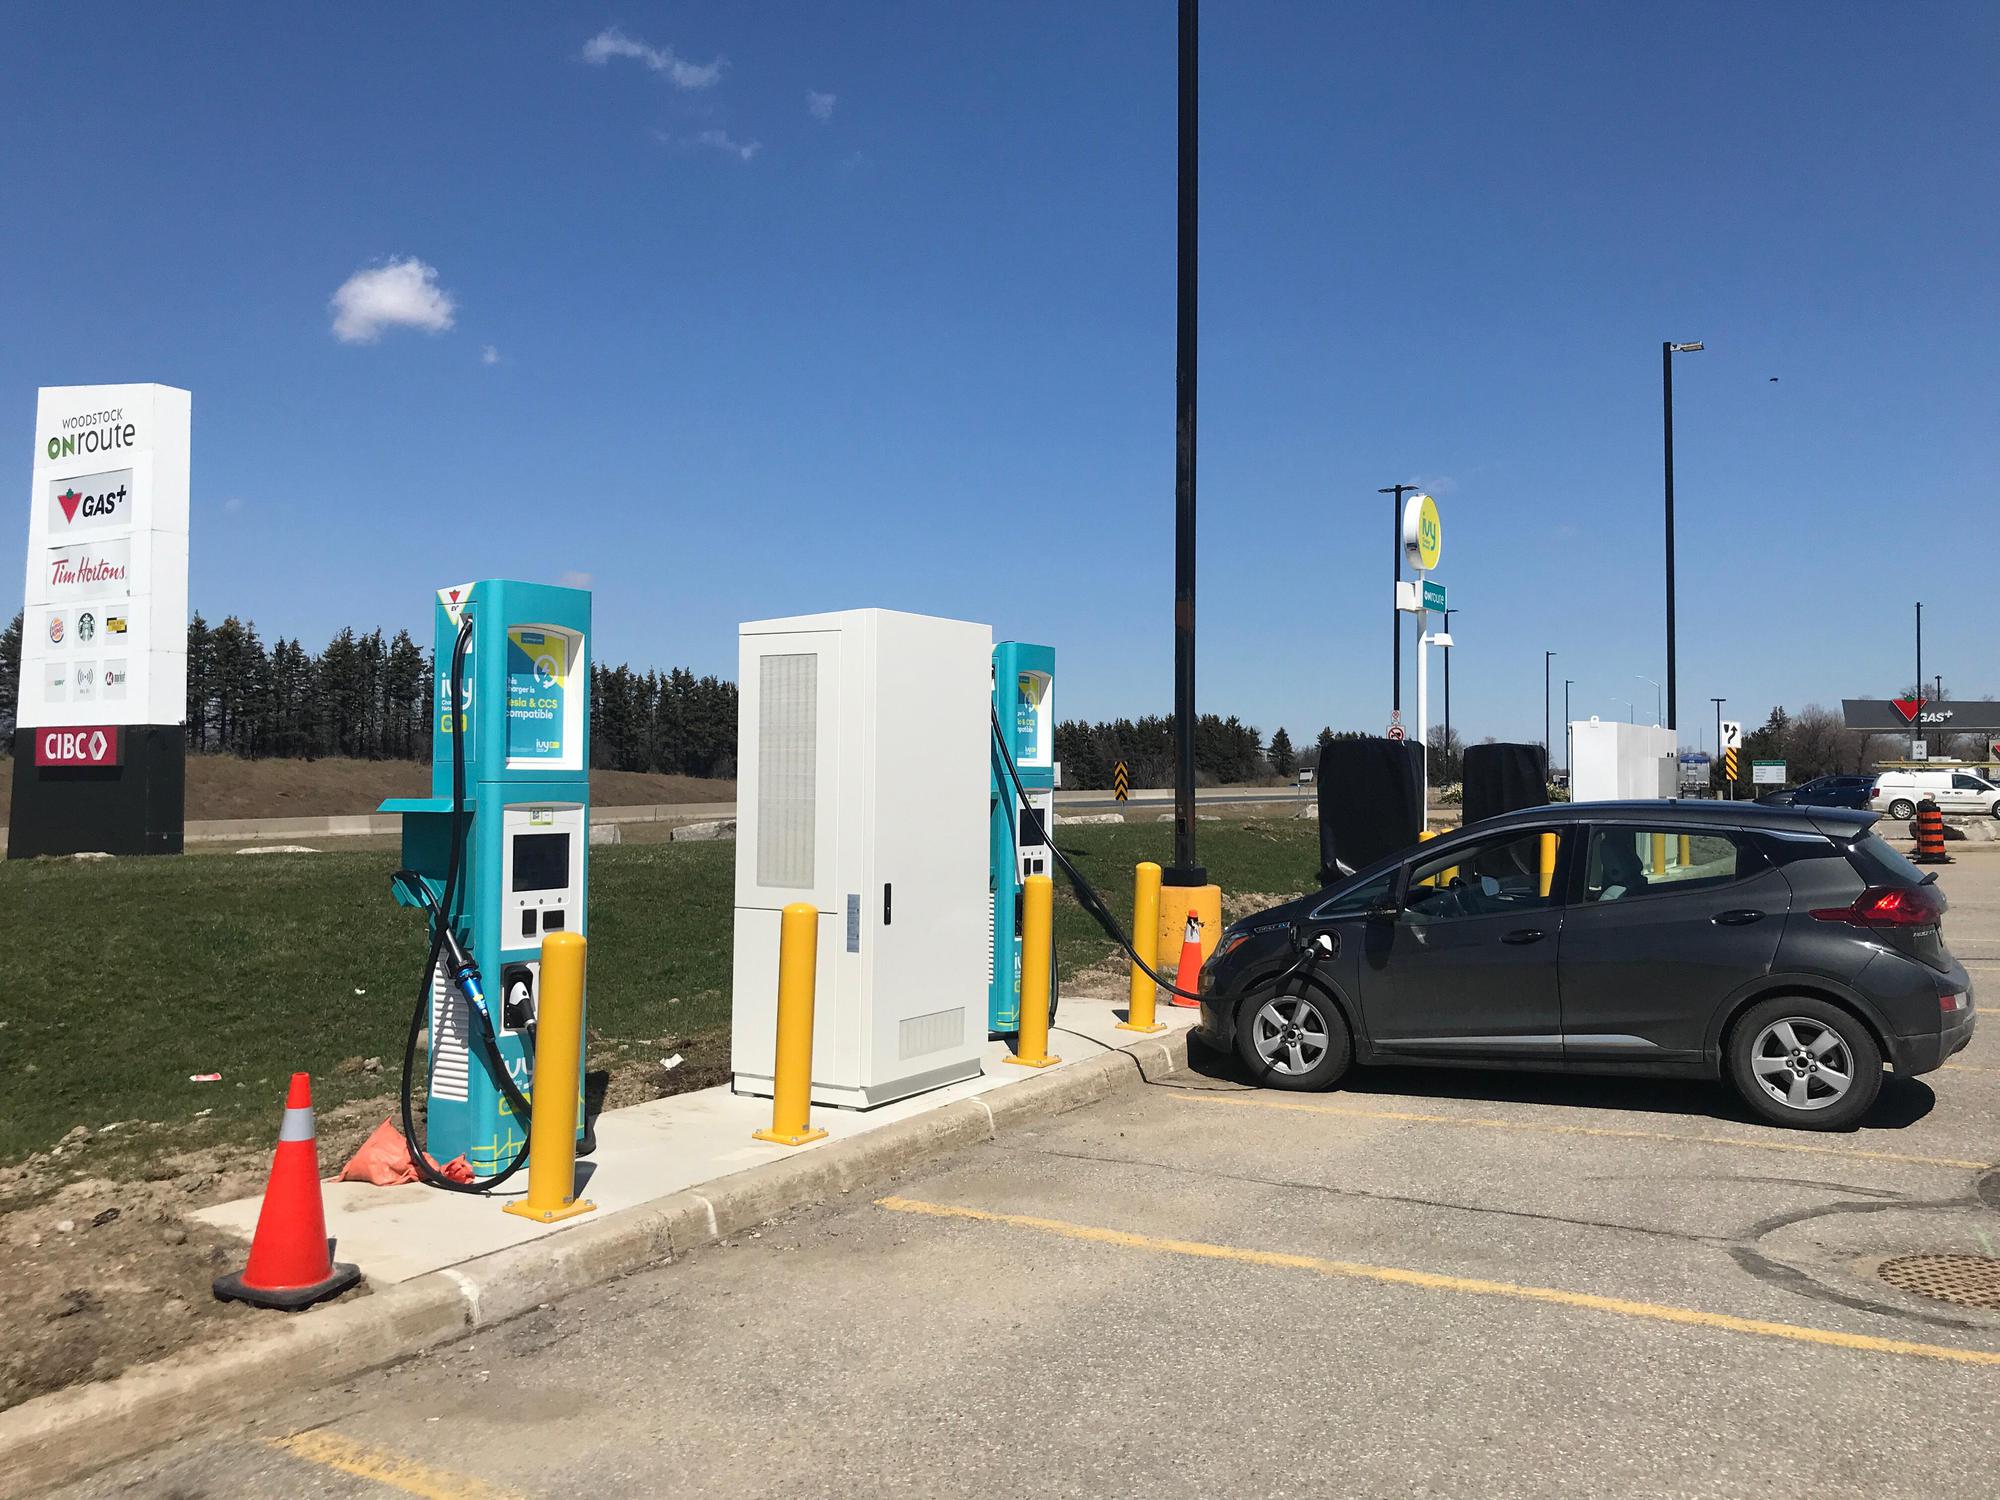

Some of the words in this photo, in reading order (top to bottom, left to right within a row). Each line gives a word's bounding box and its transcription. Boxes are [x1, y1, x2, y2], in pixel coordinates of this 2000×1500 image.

[62, 408, 123, 429] WOODSTOCK
[47, 423, 136, 460] ONroute
[82, 484, 127, 518] GAS+
[1422, 511, 1436, 551] ivy
[52, 559, 76, 585] Tim
[77, 556, 125, 583] Hortons
[507, 697, 527, 708] esla
[529, 698, 536, 708] &
[538, 698, 558, 709] CCS
[45, 733, 87, 760] CIBC
